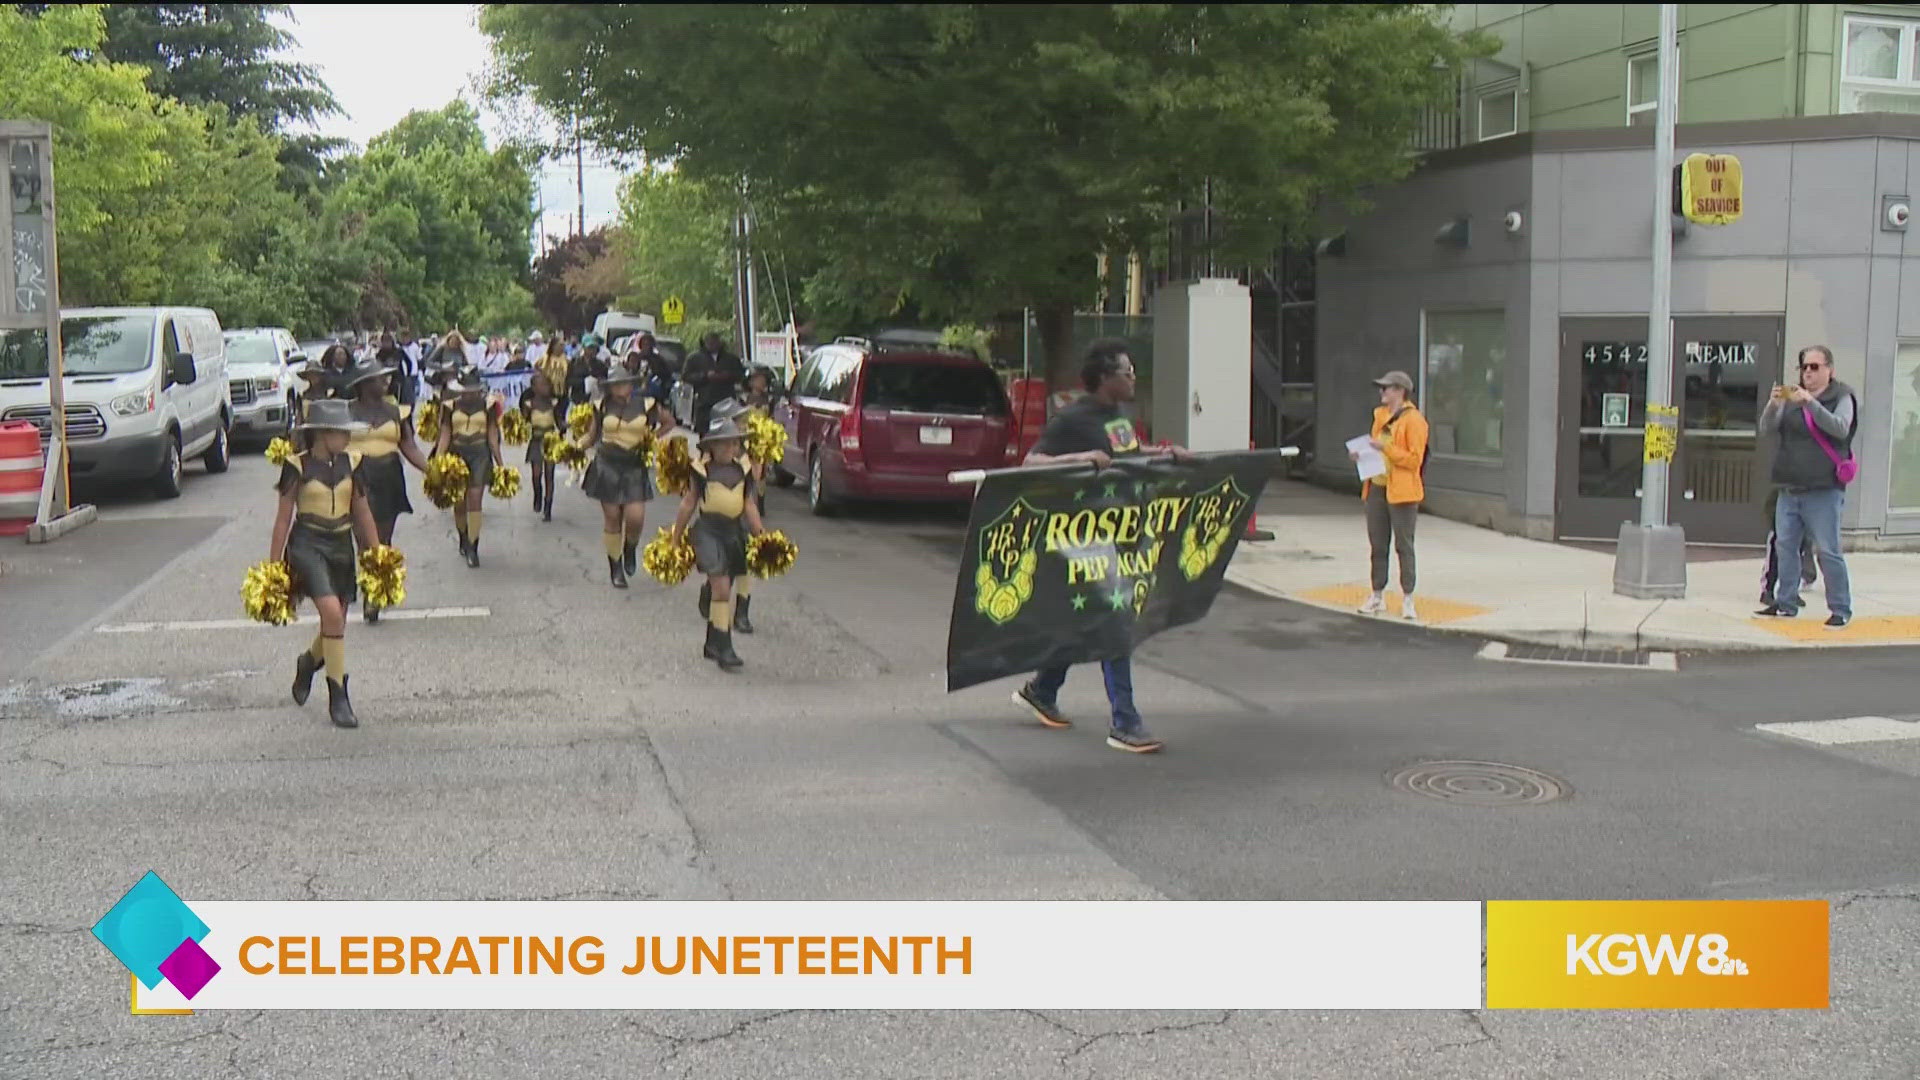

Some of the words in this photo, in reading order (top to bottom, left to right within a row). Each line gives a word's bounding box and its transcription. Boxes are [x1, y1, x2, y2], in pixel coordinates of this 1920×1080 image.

[1705, 158, 1726, 173] OUT
[1711, 178, 1723, 192] OF
[1697, 198, 1740, 213] SERVICE
[1045, 505, 1141, 553] ROSE
[1068, 554, 1110, 585] PEP
